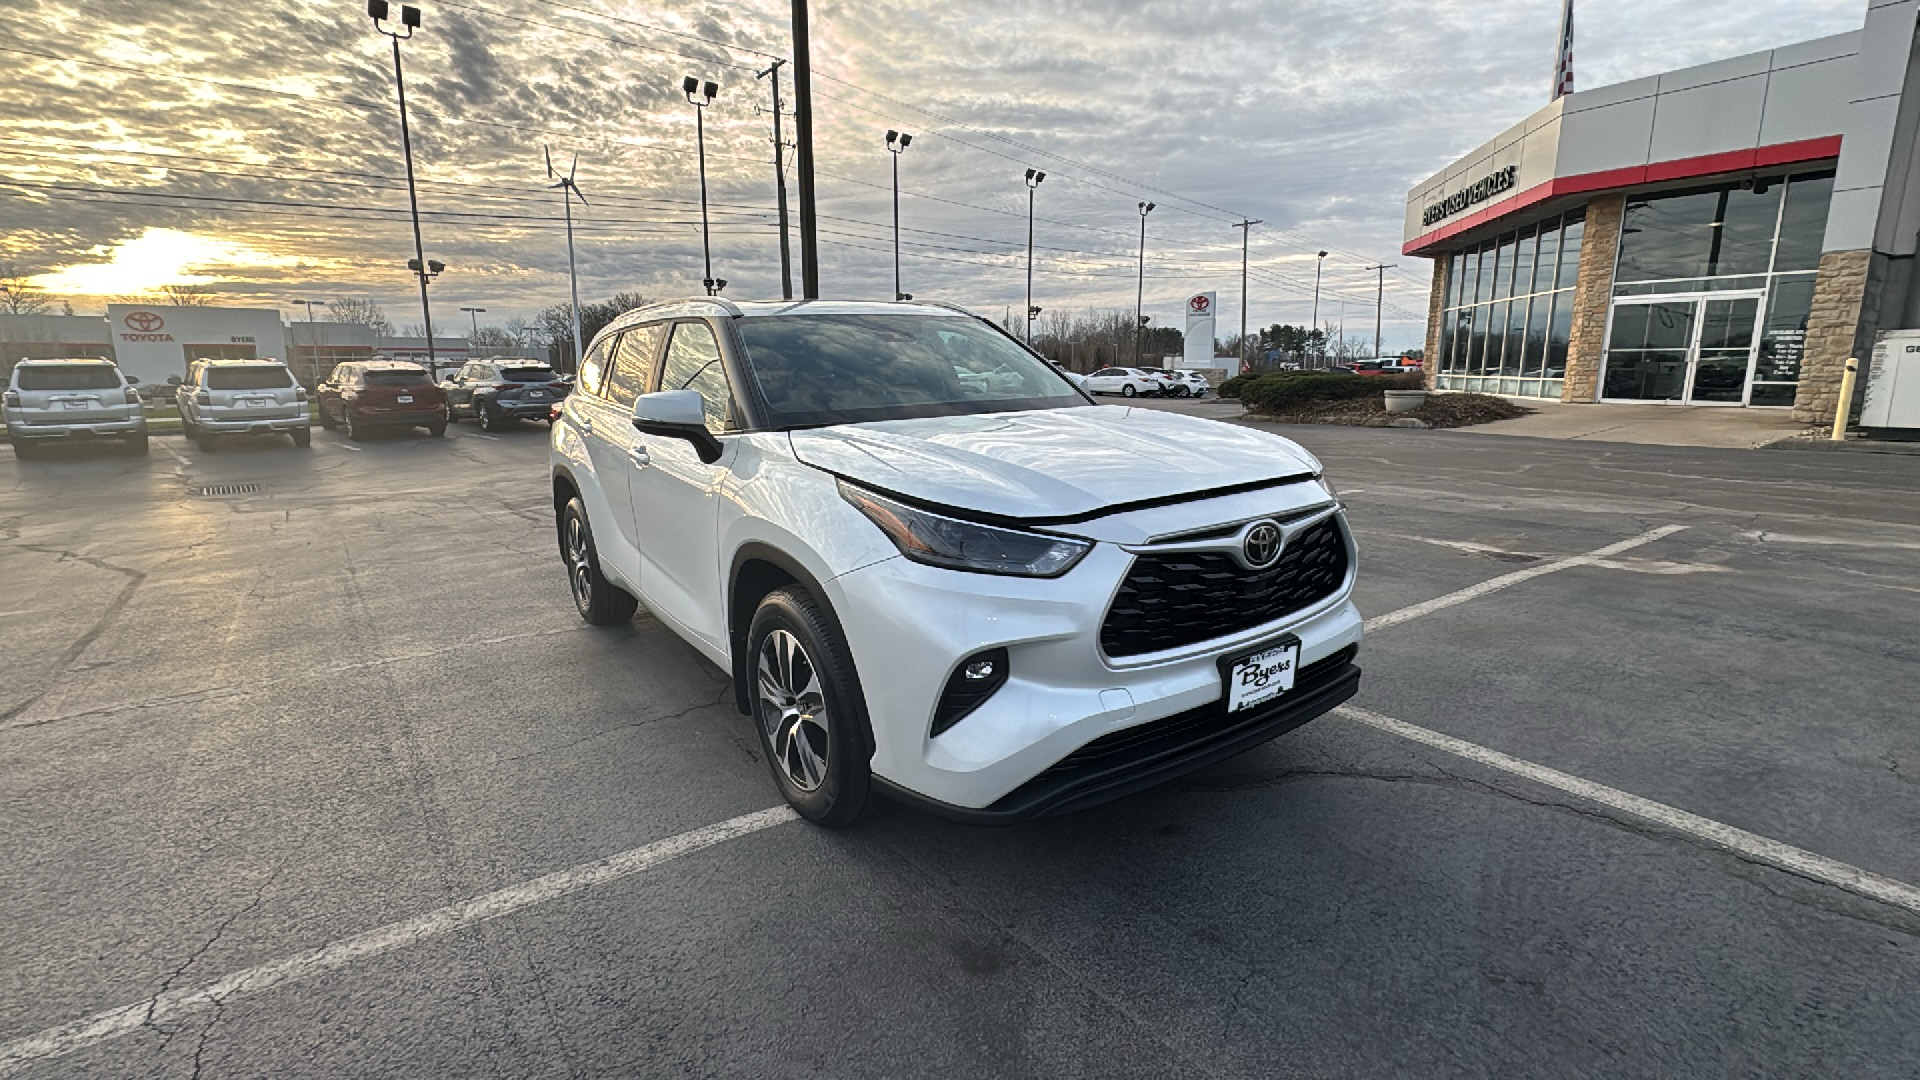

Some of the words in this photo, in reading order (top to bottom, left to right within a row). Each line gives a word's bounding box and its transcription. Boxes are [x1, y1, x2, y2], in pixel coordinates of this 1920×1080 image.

[1422, 199, 1447, 226] BYERS
[1445, 187, 1470, 215] USED
[1467, 165, 1516, 205] VEHICLES
[120, 333, 174, 342] TOYOTA
